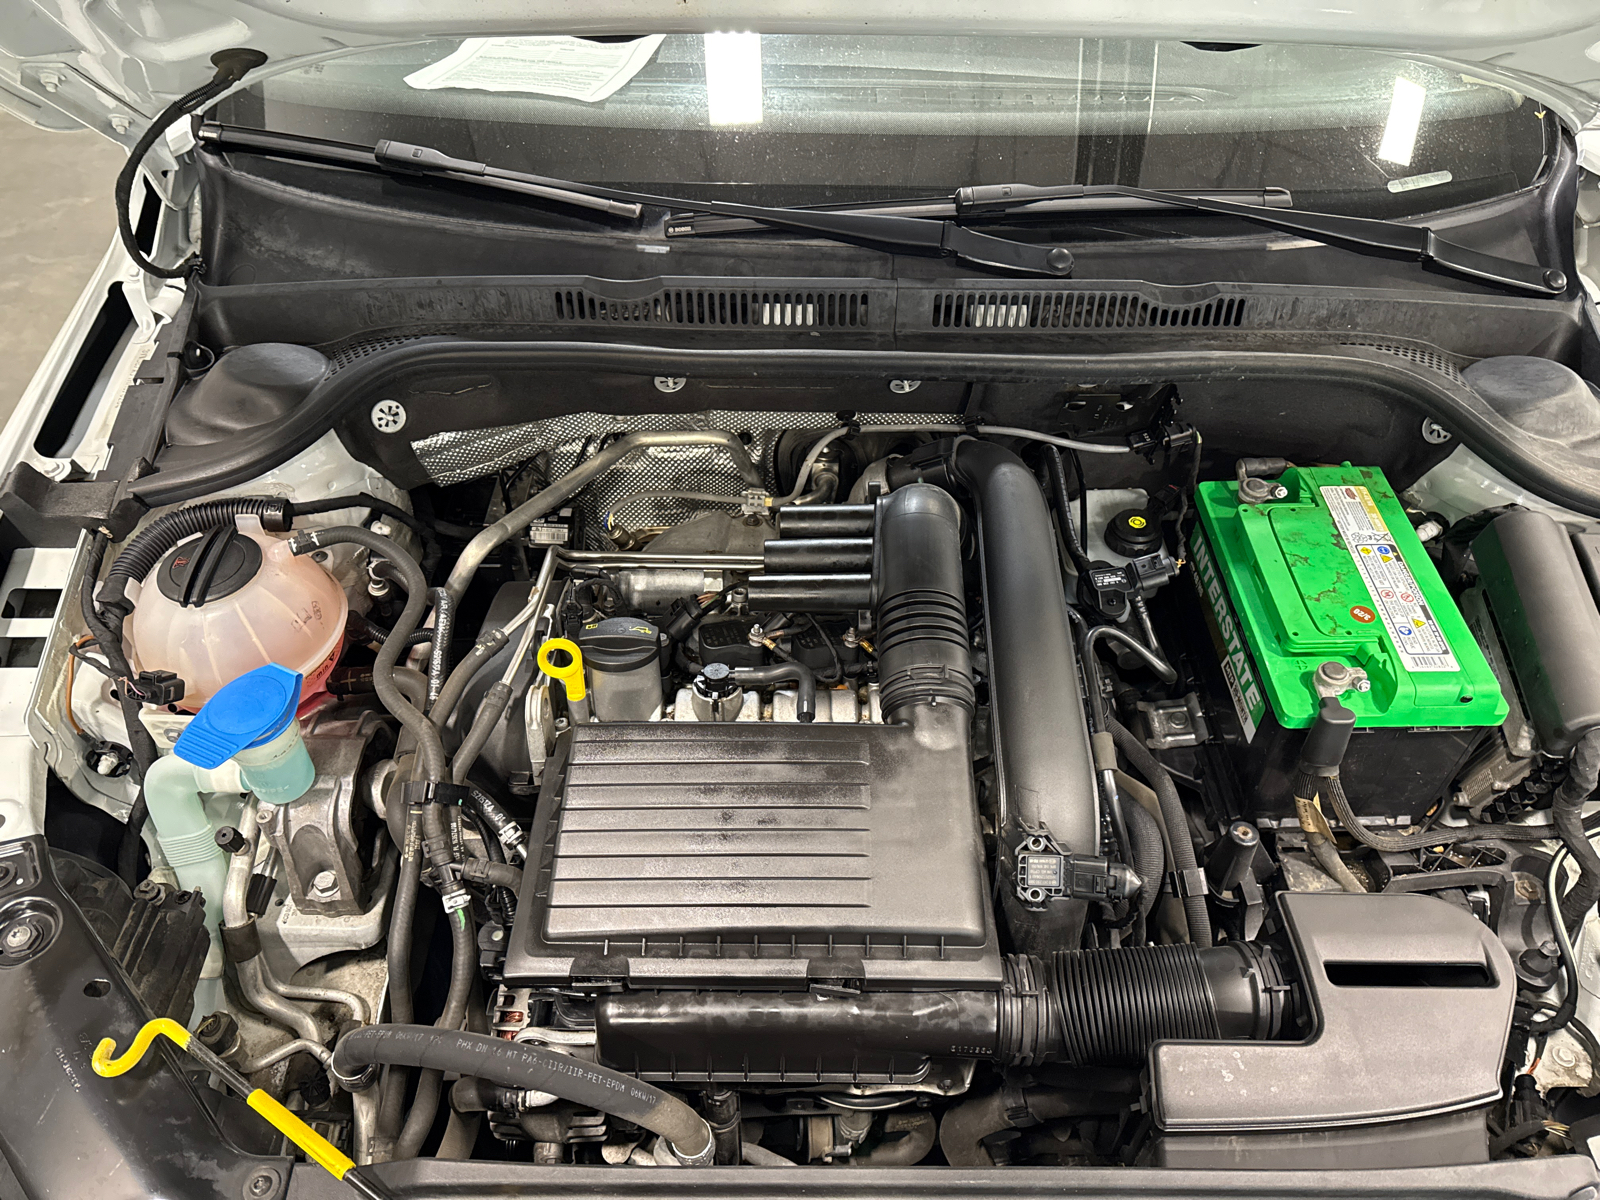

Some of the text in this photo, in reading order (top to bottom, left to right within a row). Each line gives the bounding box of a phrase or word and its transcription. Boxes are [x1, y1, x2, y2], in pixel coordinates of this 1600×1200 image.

[1193, 535, 1260, 710] INTERSTATE
[1353, 608, 1371, 621] 3/20
[316, 664, 330, 679] min
[456, 1038, 472, 1050] PHX
[475, 1042, 487, 1053] DN
[506, 1050, 517, 1059] MT
